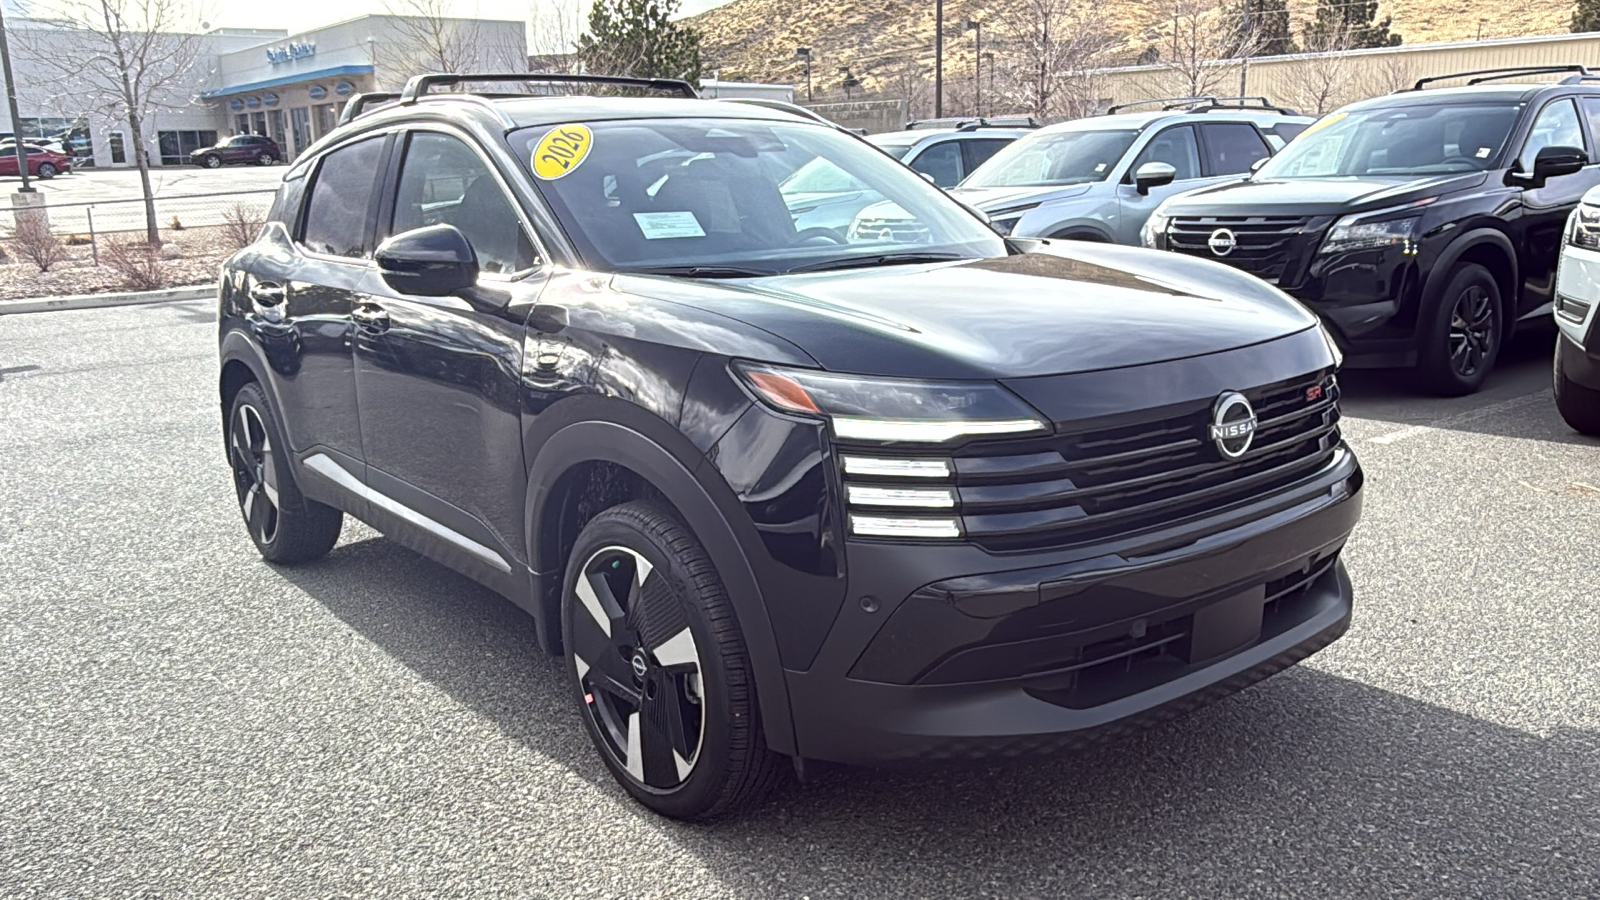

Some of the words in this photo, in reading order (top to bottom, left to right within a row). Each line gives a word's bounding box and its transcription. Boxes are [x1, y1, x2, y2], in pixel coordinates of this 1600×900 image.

[542, 129, 584, 169] 2026
[1209, 239, 1236, 247] SSAN
[1306, 385, 1321, 401] SR
[1212, 418, 1258, 438] NISSAN
